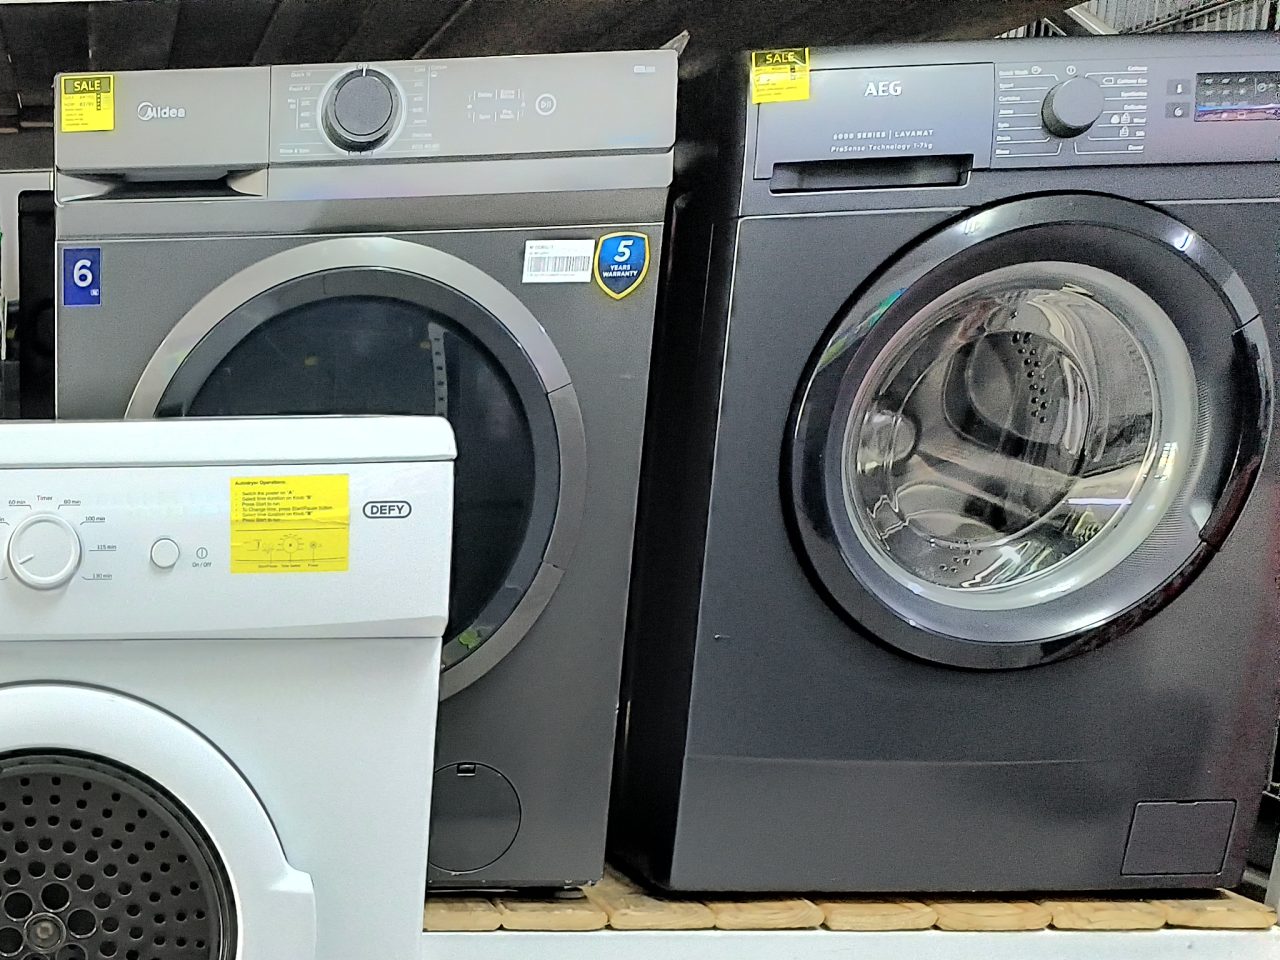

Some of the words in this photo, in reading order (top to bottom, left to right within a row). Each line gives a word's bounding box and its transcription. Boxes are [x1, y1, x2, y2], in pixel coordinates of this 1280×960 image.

[766, 52, 795, 64] SALE
[73, 80, 101, 91] SALE
[864, 81, 902, 96] AEG
[138, 103, 185, 119] Midea
[857, 131, 886, 139] SERIES
[894, 129, 934, 138] LAVAMAT
[830, 145, 866, 153] ProSense
[868, 143, 911, 151] Technology
[614, 240, 634, 262] 5
[74, 259, 93, 287] 6
[602, 270, 638, 278] WARRANTY
[370, 504, 405, 515] DEFY
